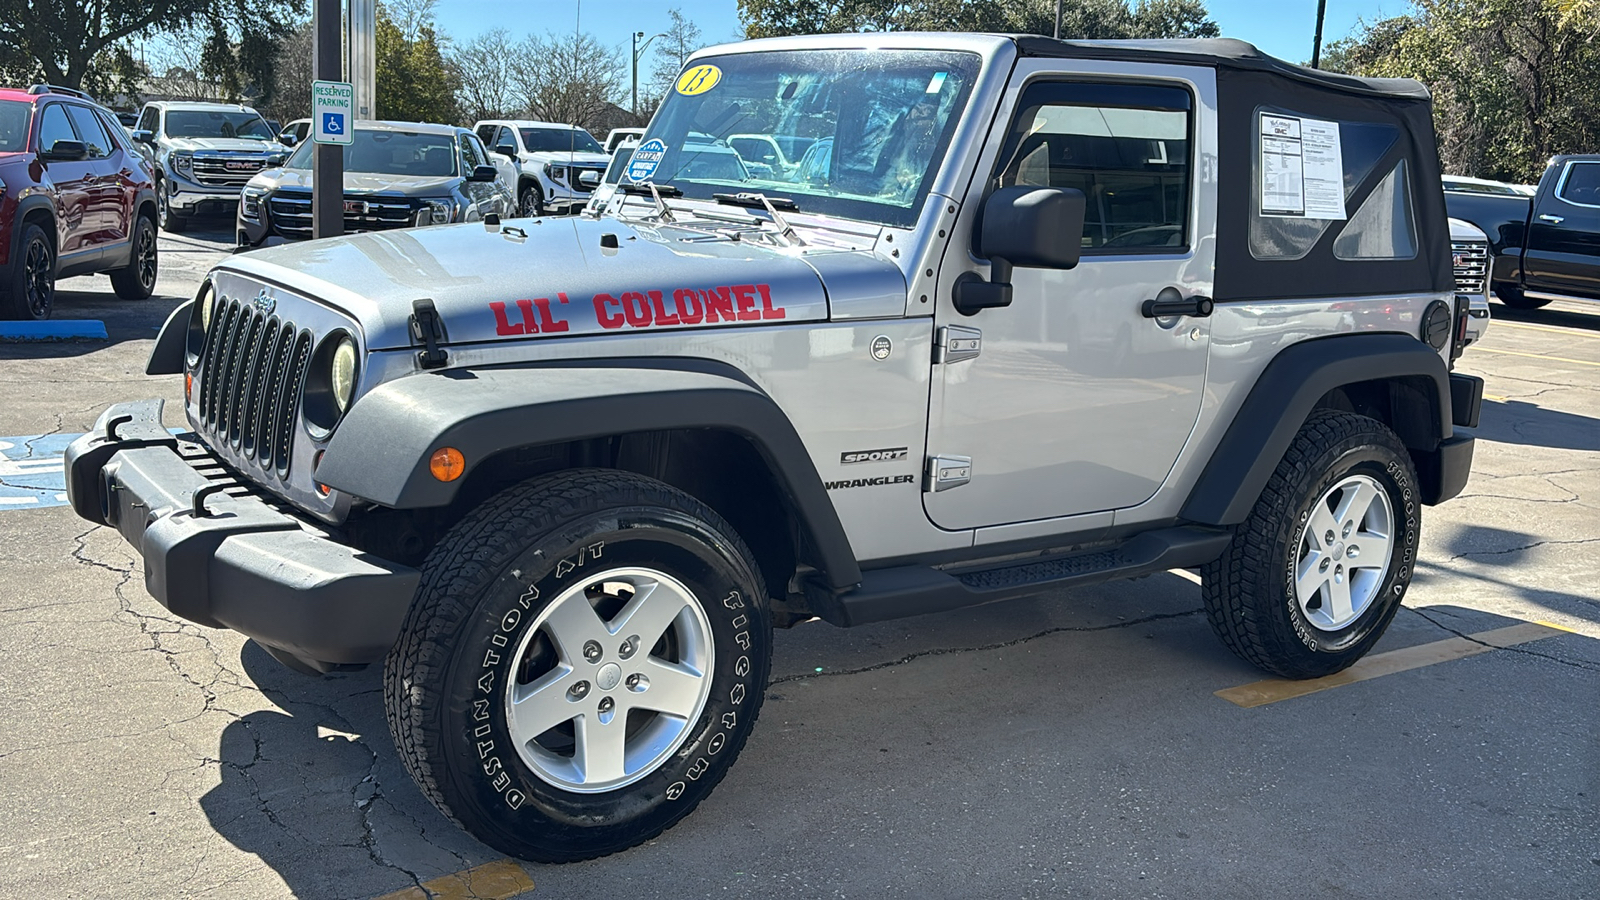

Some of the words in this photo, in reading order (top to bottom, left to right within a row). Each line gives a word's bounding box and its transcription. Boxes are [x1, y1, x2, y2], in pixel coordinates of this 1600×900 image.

[682, 68, 712, 92] 13
[315, 86, 351, 98] RESERVED
[317, 97, 349, 108] PARKING
[225, 161, 260, 169] GMC
[253, 288, 277, 314] Jeep
[490, 292, 569, 336] LIL'
[592, 283, 786, 329] COLONEL
[842, 449, 907, 463] SPORT
[825, 474, 914, 490] WRANGLER
[1286, 523, 1318, 653] DESTINATION
[473, 584, 540, 811] DESTINATION
[555, 541, 605, 579] A/T
